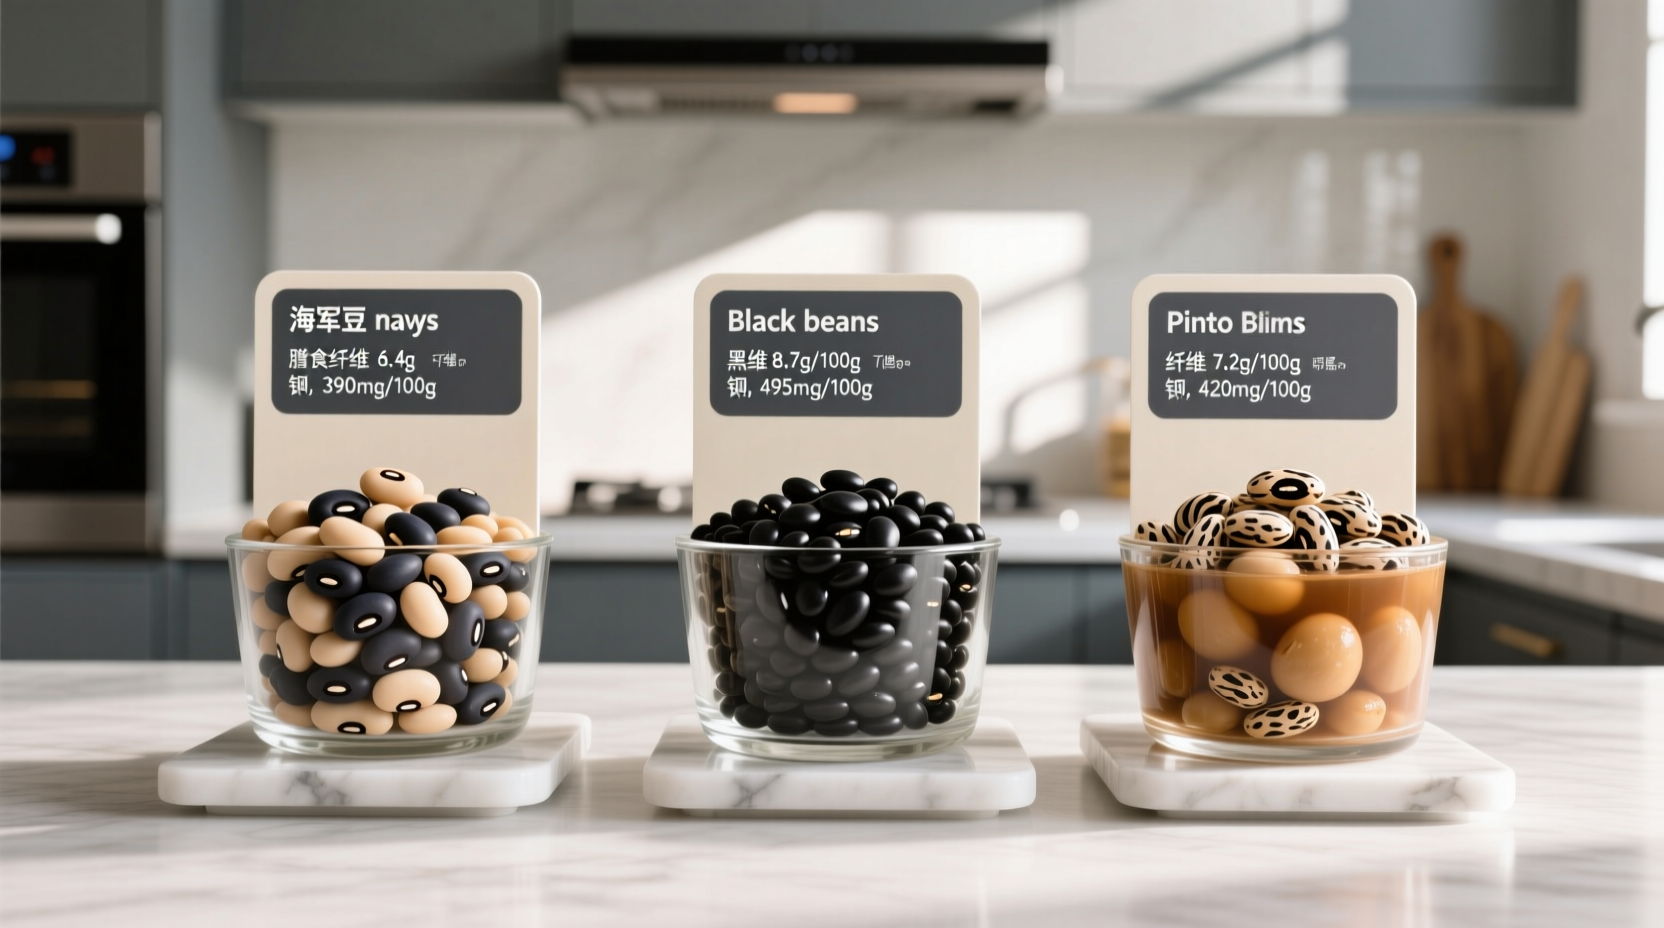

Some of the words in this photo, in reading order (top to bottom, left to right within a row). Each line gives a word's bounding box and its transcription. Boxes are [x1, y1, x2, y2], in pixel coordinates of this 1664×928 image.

[289, 305, 367, 334] 海军豆
[728, 308, 796, 333] Black
[804, 308, 880, 333] beans
[1167, 309, 1234, 334] Pinto
[377, 349, 416, 374] 6.4g
[726, 348, 768, 372] 黑维
[772, 350, 861, 375] 8.7g/100g
[1165, 350, 1207, 373] 纤维
[1212, 352, 1302, 376] 7.2g/100g
[322, 375, 437, 400] 390mg/100g
[759, 377, 873, 402] 495mg/100g
[1198, 378, 1312, 404] 420mg/100g
